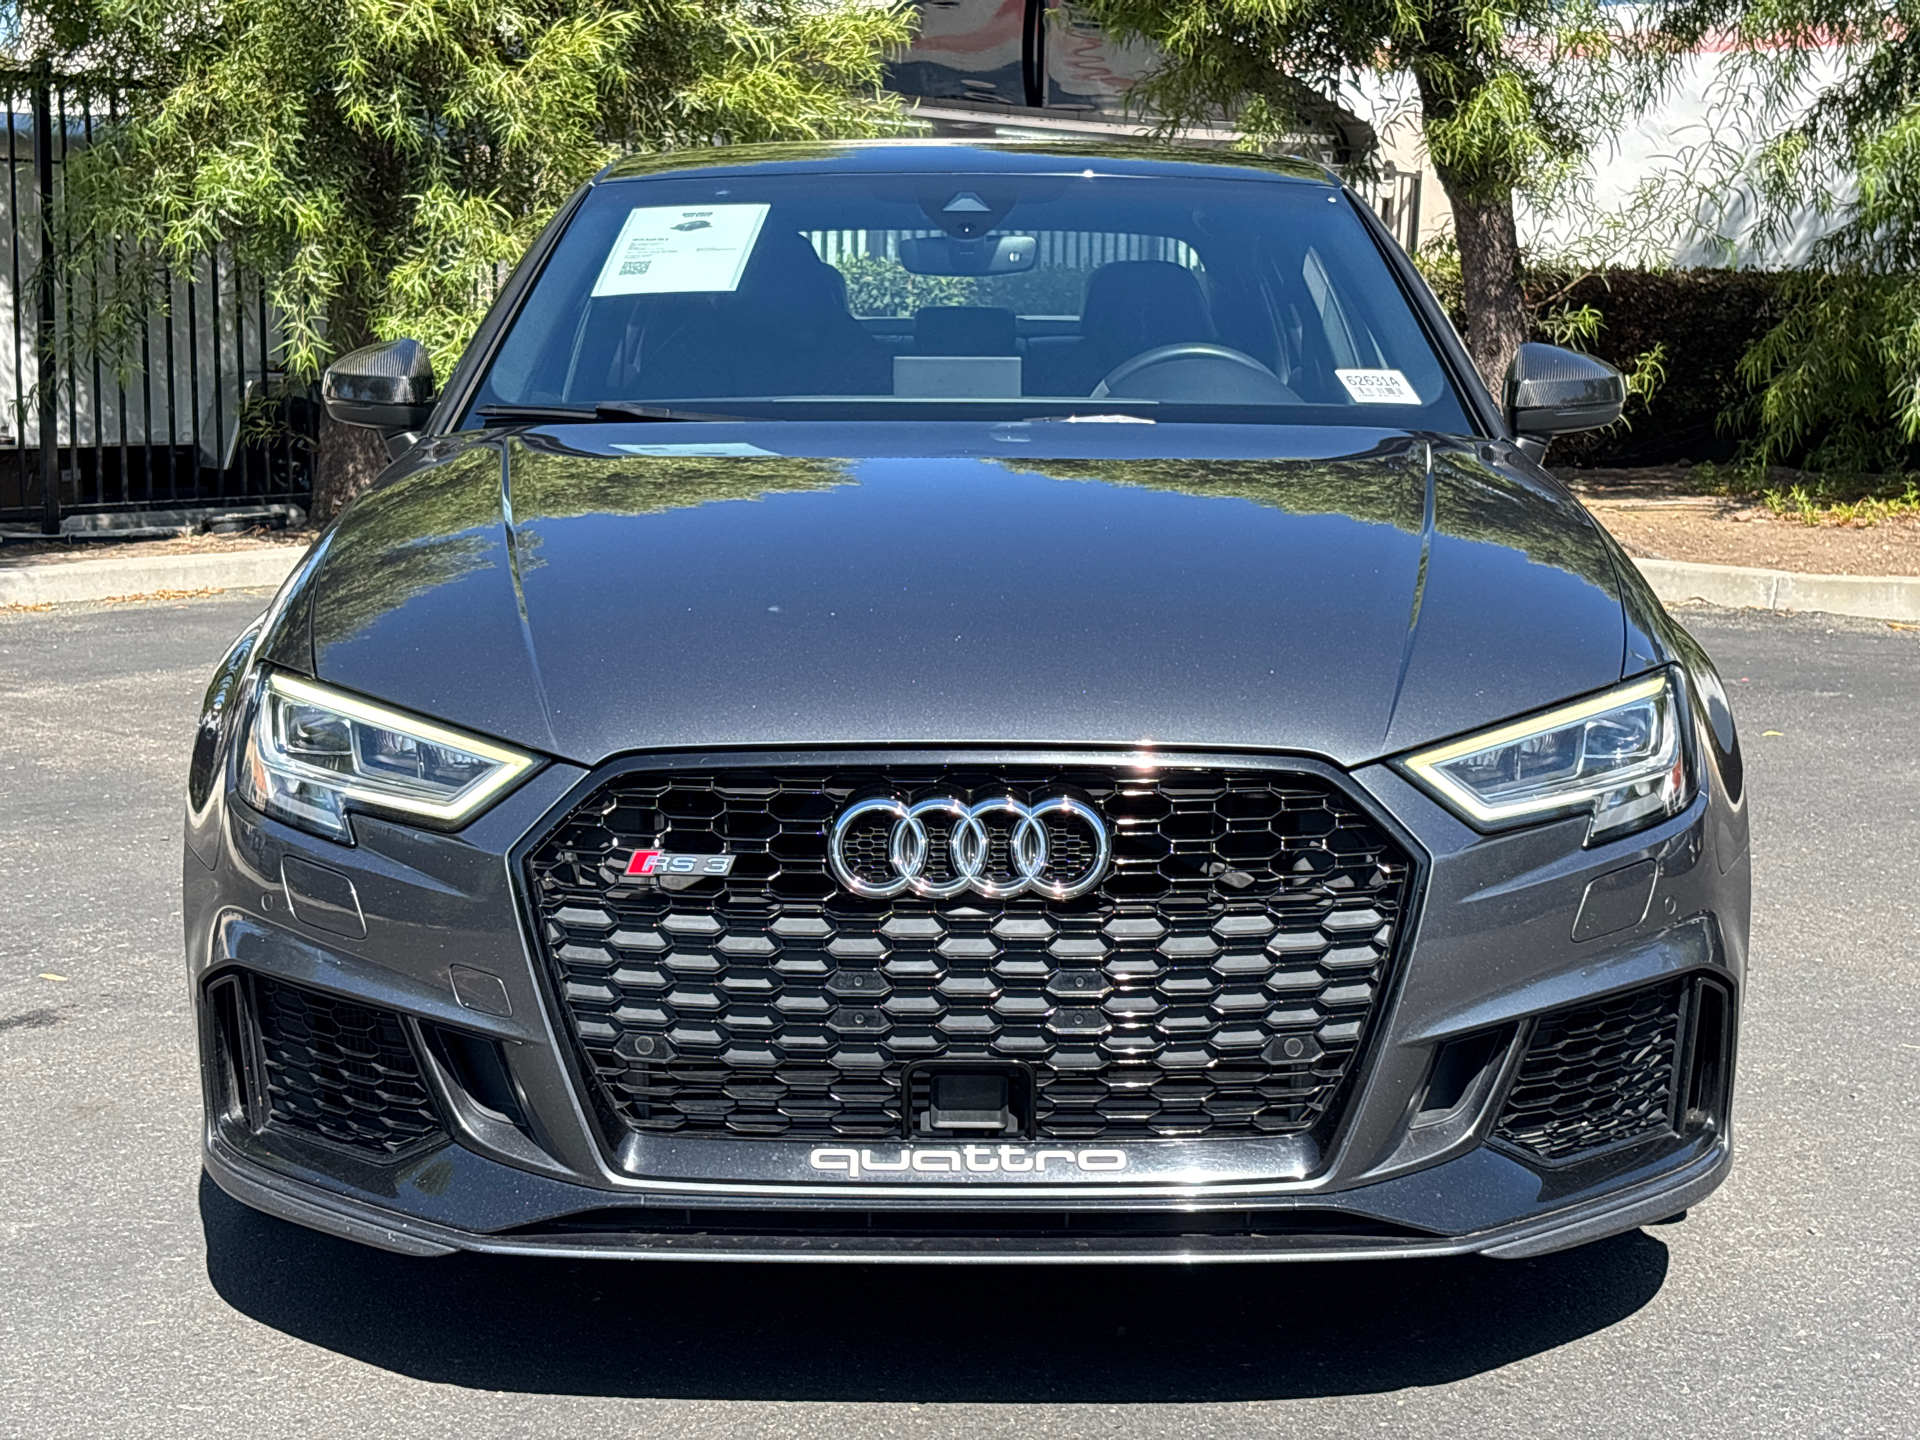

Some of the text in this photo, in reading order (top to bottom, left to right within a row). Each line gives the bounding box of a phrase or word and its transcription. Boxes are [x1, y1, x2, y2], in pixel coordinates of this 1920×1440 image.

[1346, 375, 1401, 387] 62631A
[641, 855, 730, 873] RS 3
[810, 1144, 1127, 1179] quattro
